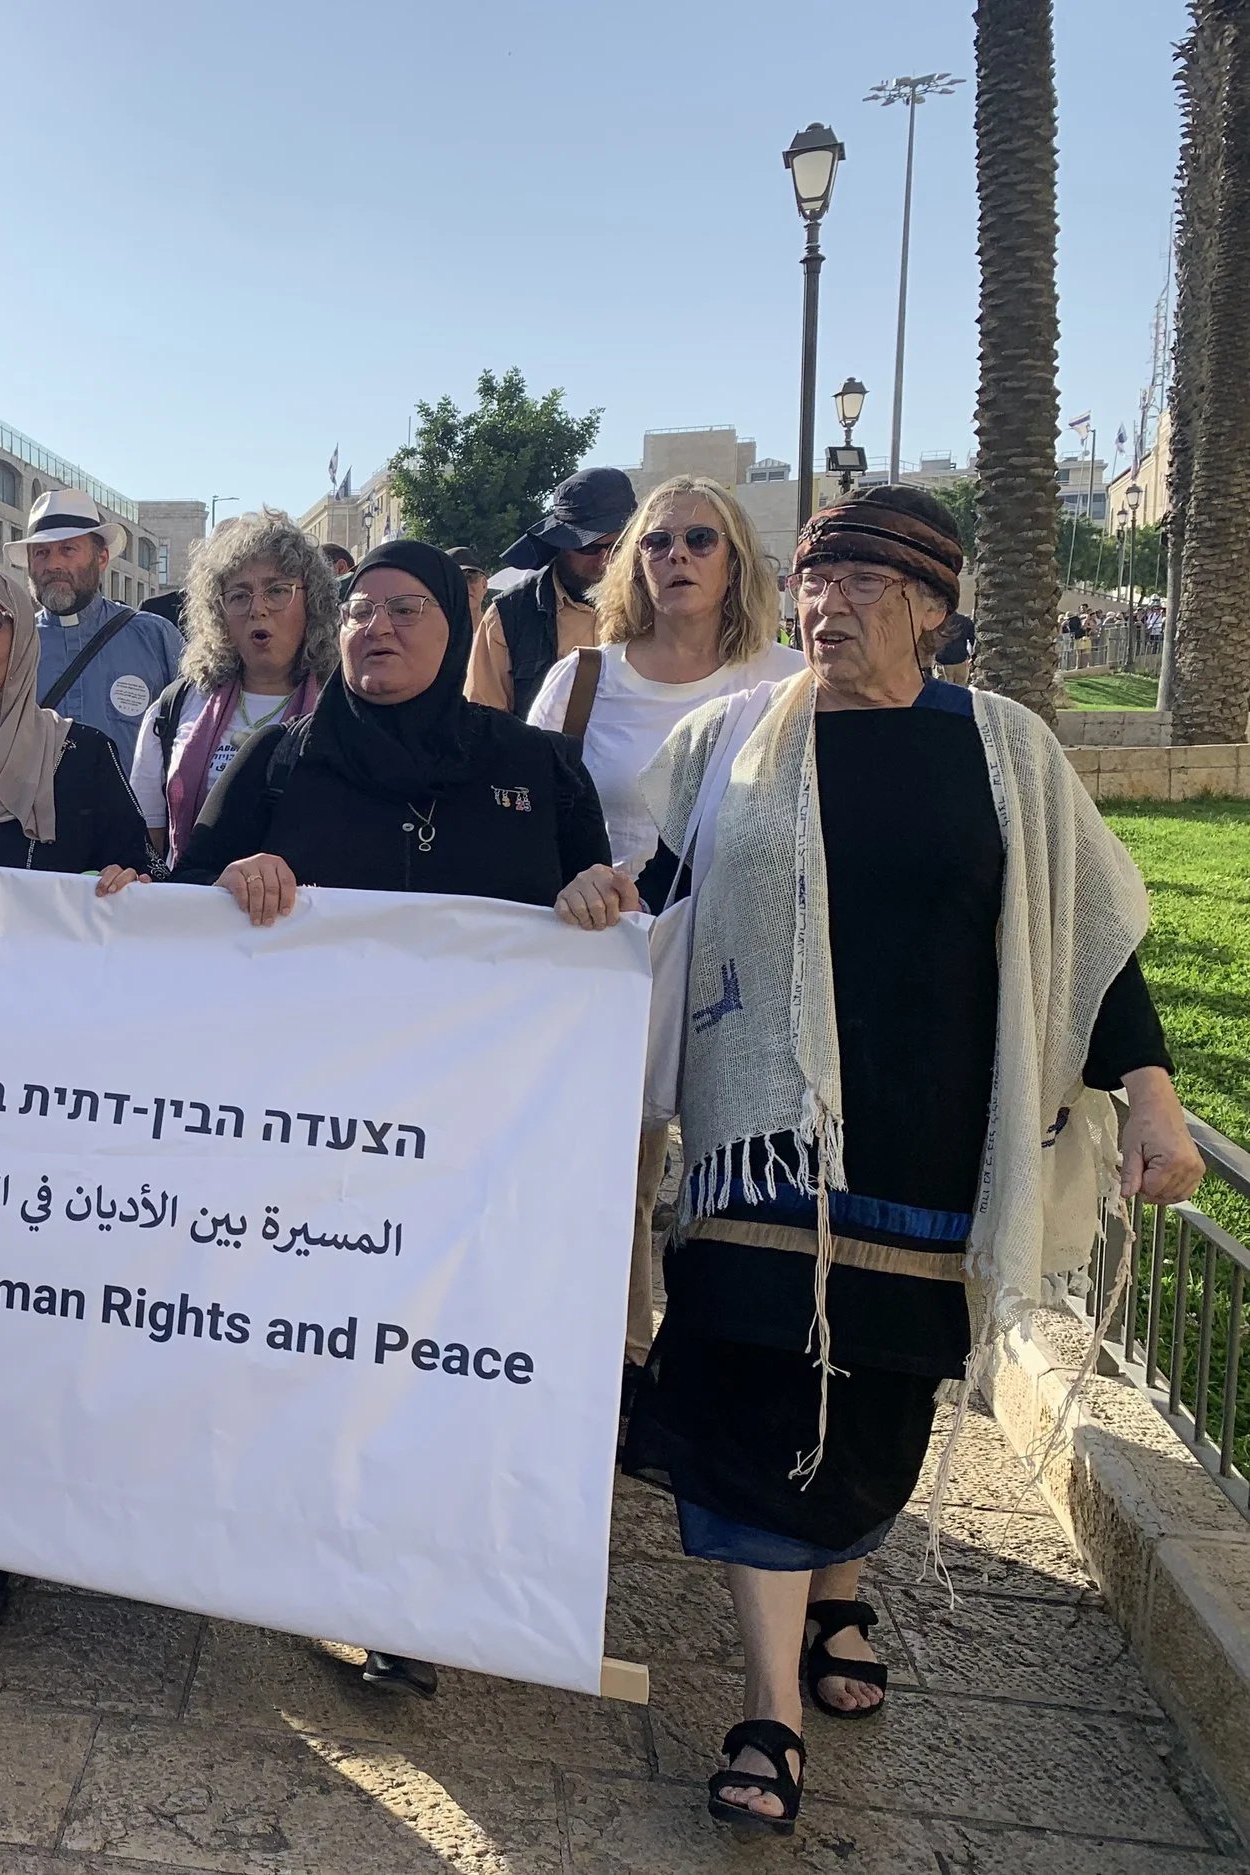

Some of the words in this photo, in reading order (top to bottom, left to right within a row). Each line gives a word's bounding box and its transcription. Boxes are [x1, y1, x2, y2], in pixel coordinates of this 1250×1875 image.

[19, 1084, 244, 1139] הבין-דתית
[263, 1110, 425, 1159] הצעדה
[21, 1175, 51, 1232] في
[66, 1184, 177, 1231] الأديان
[191, 1208, 246, 1249] بين
[262, 1206, 401, 1256] المسيرة
[102, 1285, 250, 1343] Rights
[267, 1317, 357, 1360] and
[375, 1323, 533, 1384] Peace
